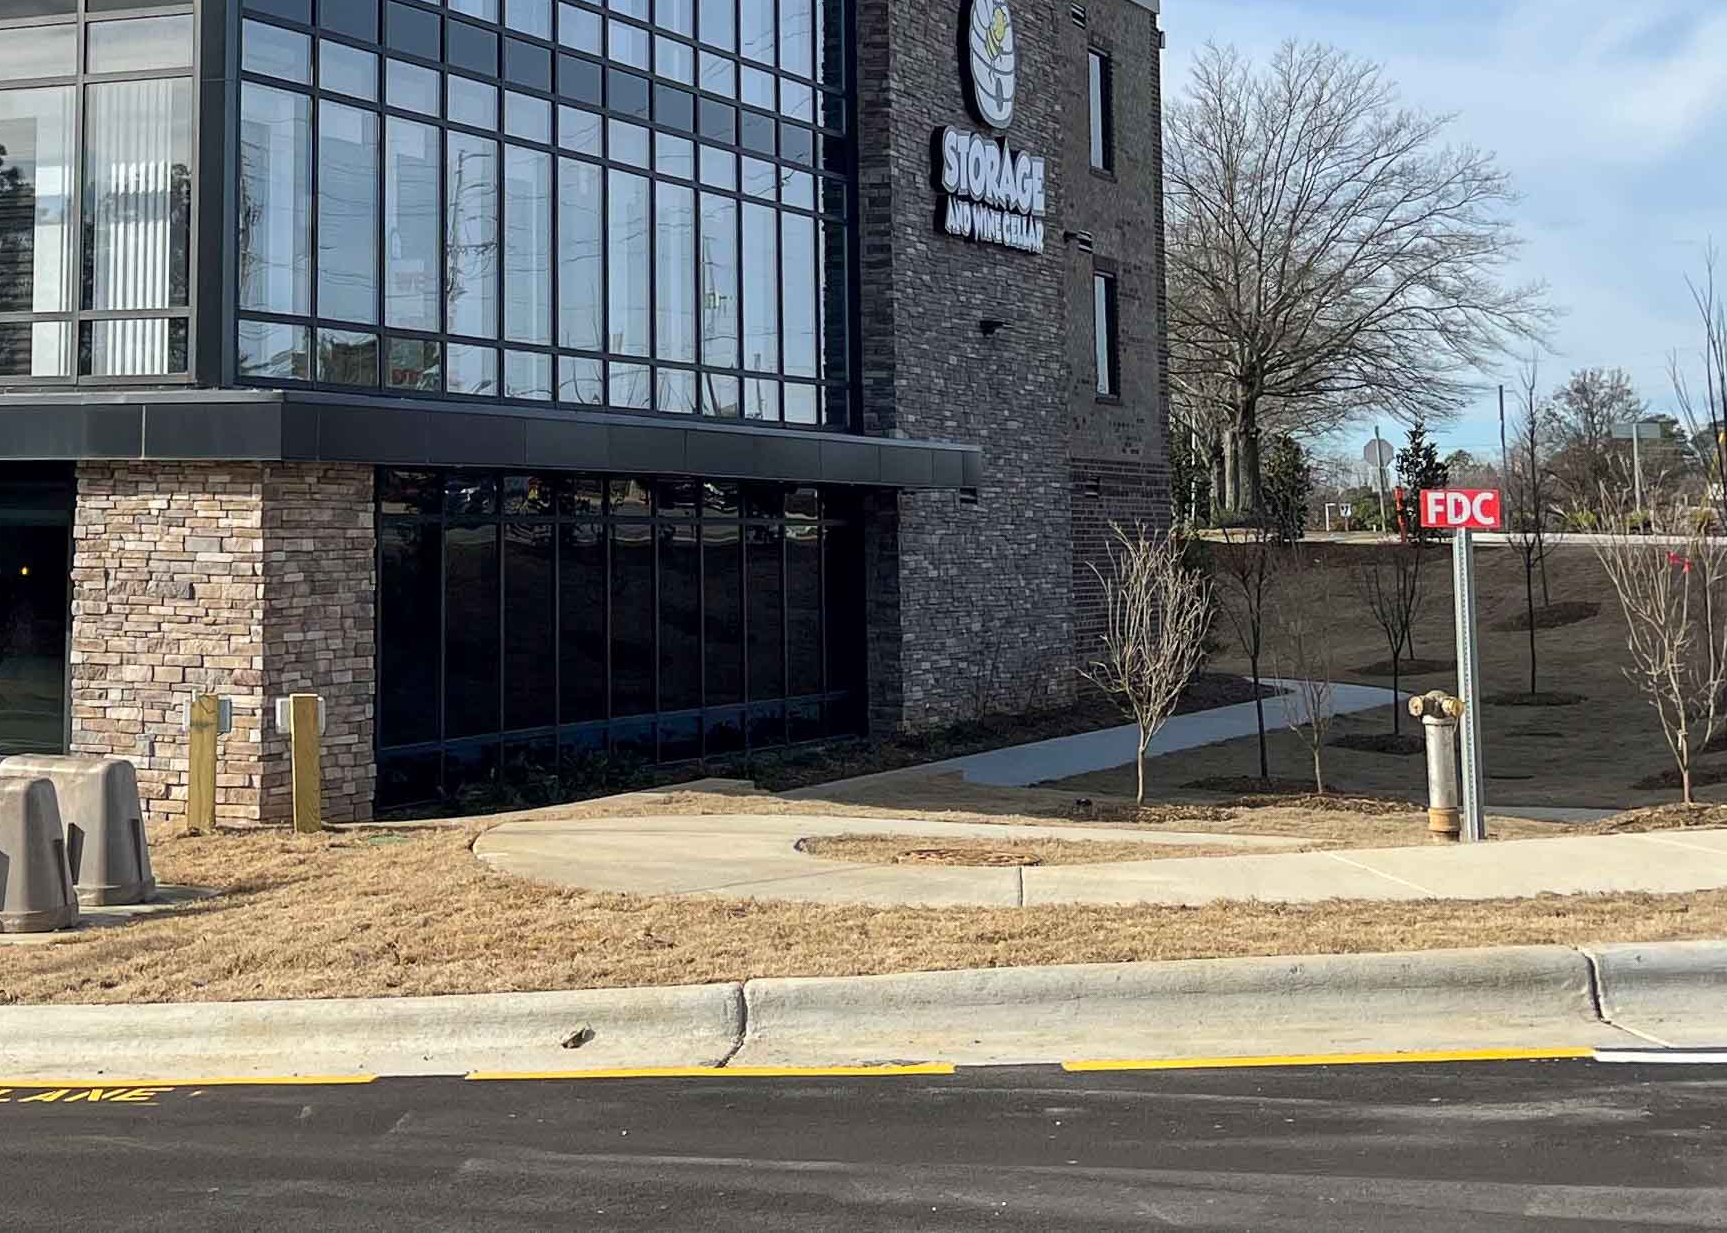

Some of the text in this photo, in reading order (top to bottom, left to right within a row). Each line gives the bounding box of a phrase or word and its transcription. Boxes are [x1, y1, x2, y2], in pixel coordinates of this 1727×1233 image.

[943, 129, 1045, 215] STORAGE
[945, 195, 1044, 254] AND WINE CELLAR
[1426, 491, 1495, 525] FDC
